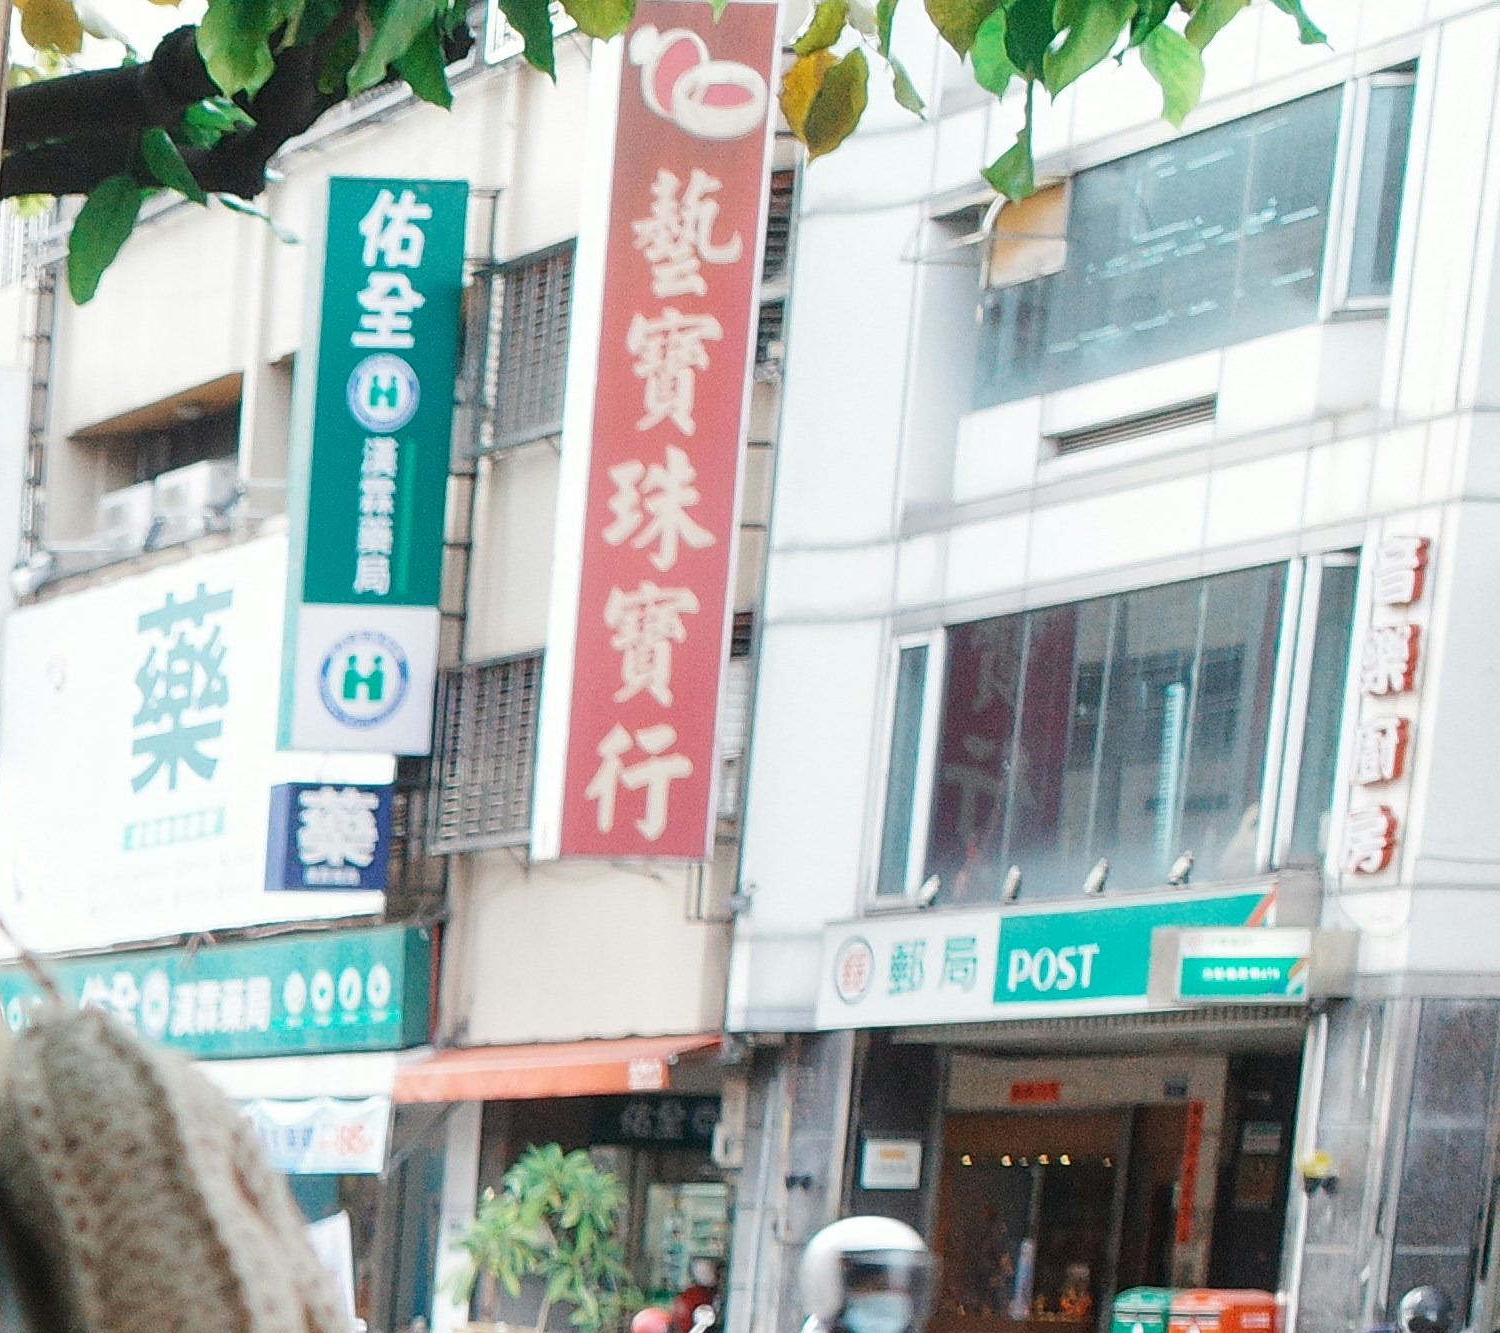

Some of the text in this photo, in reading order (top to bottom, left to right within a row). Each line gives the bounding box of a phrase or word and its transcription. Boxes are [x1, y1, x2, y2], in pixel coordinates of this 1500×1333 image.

[351, 190, 434, 349] 佑全
[586, 168, 744, 841] 藝寶珠寶行
[131, 583, 234, 794] 藥
[886, 936, 978, 995] 郵局
[1007, 942, 1101, 993] POST
